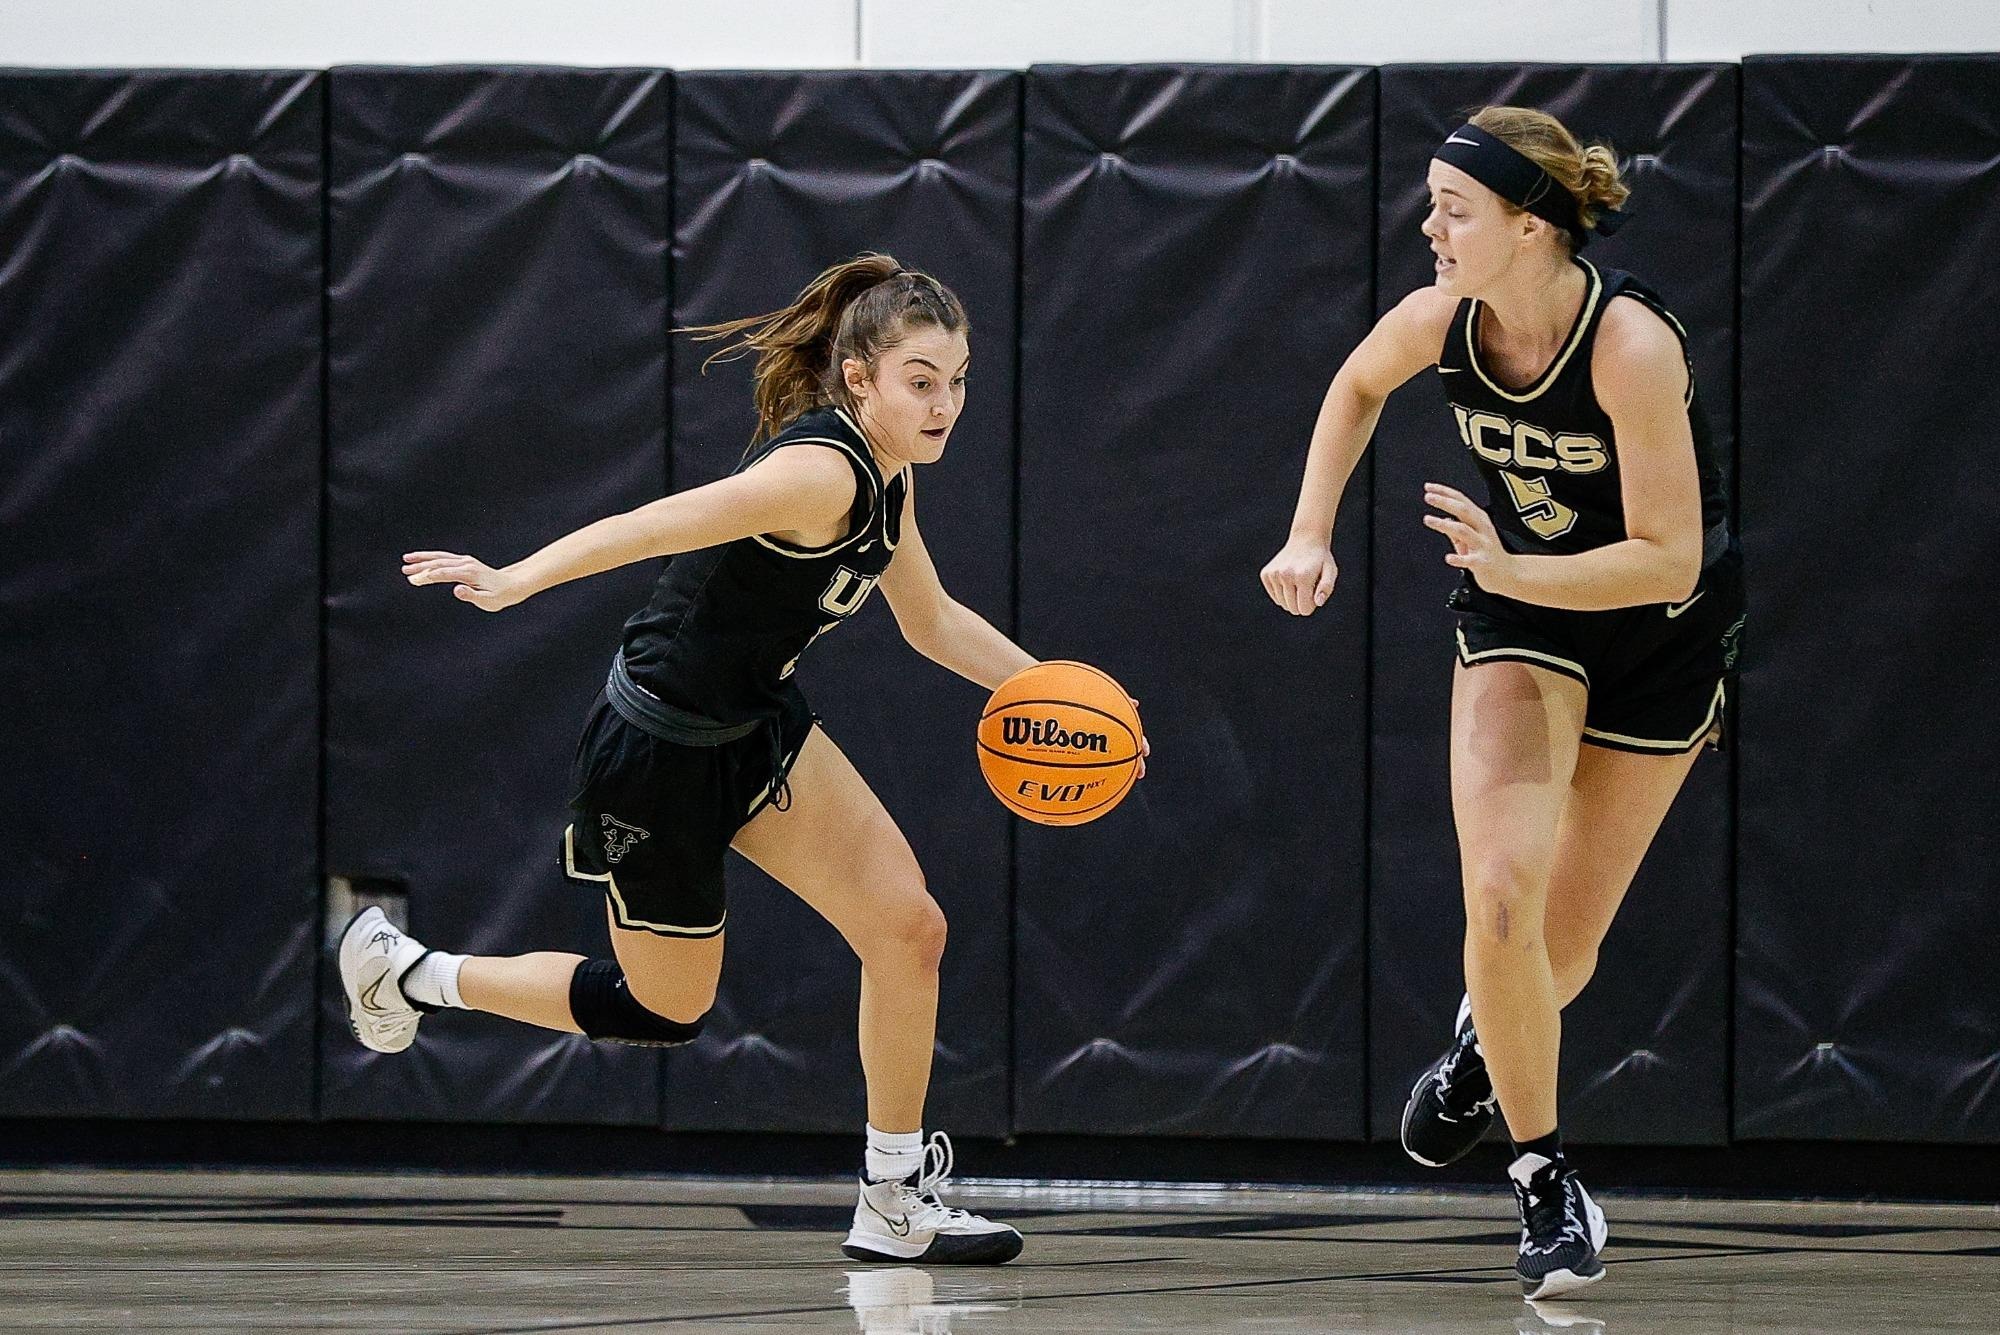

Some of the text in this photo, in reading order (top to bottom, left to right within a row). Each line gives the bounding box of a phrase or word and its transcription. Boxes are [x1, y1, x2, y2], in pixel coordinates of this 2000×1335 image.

[1499, 470, 1578, 540] 5
[818, 564, 880, 617] U
[1002, 716, 1109, 754] Wilson
[1017, 779, 1085, 802] EVO
